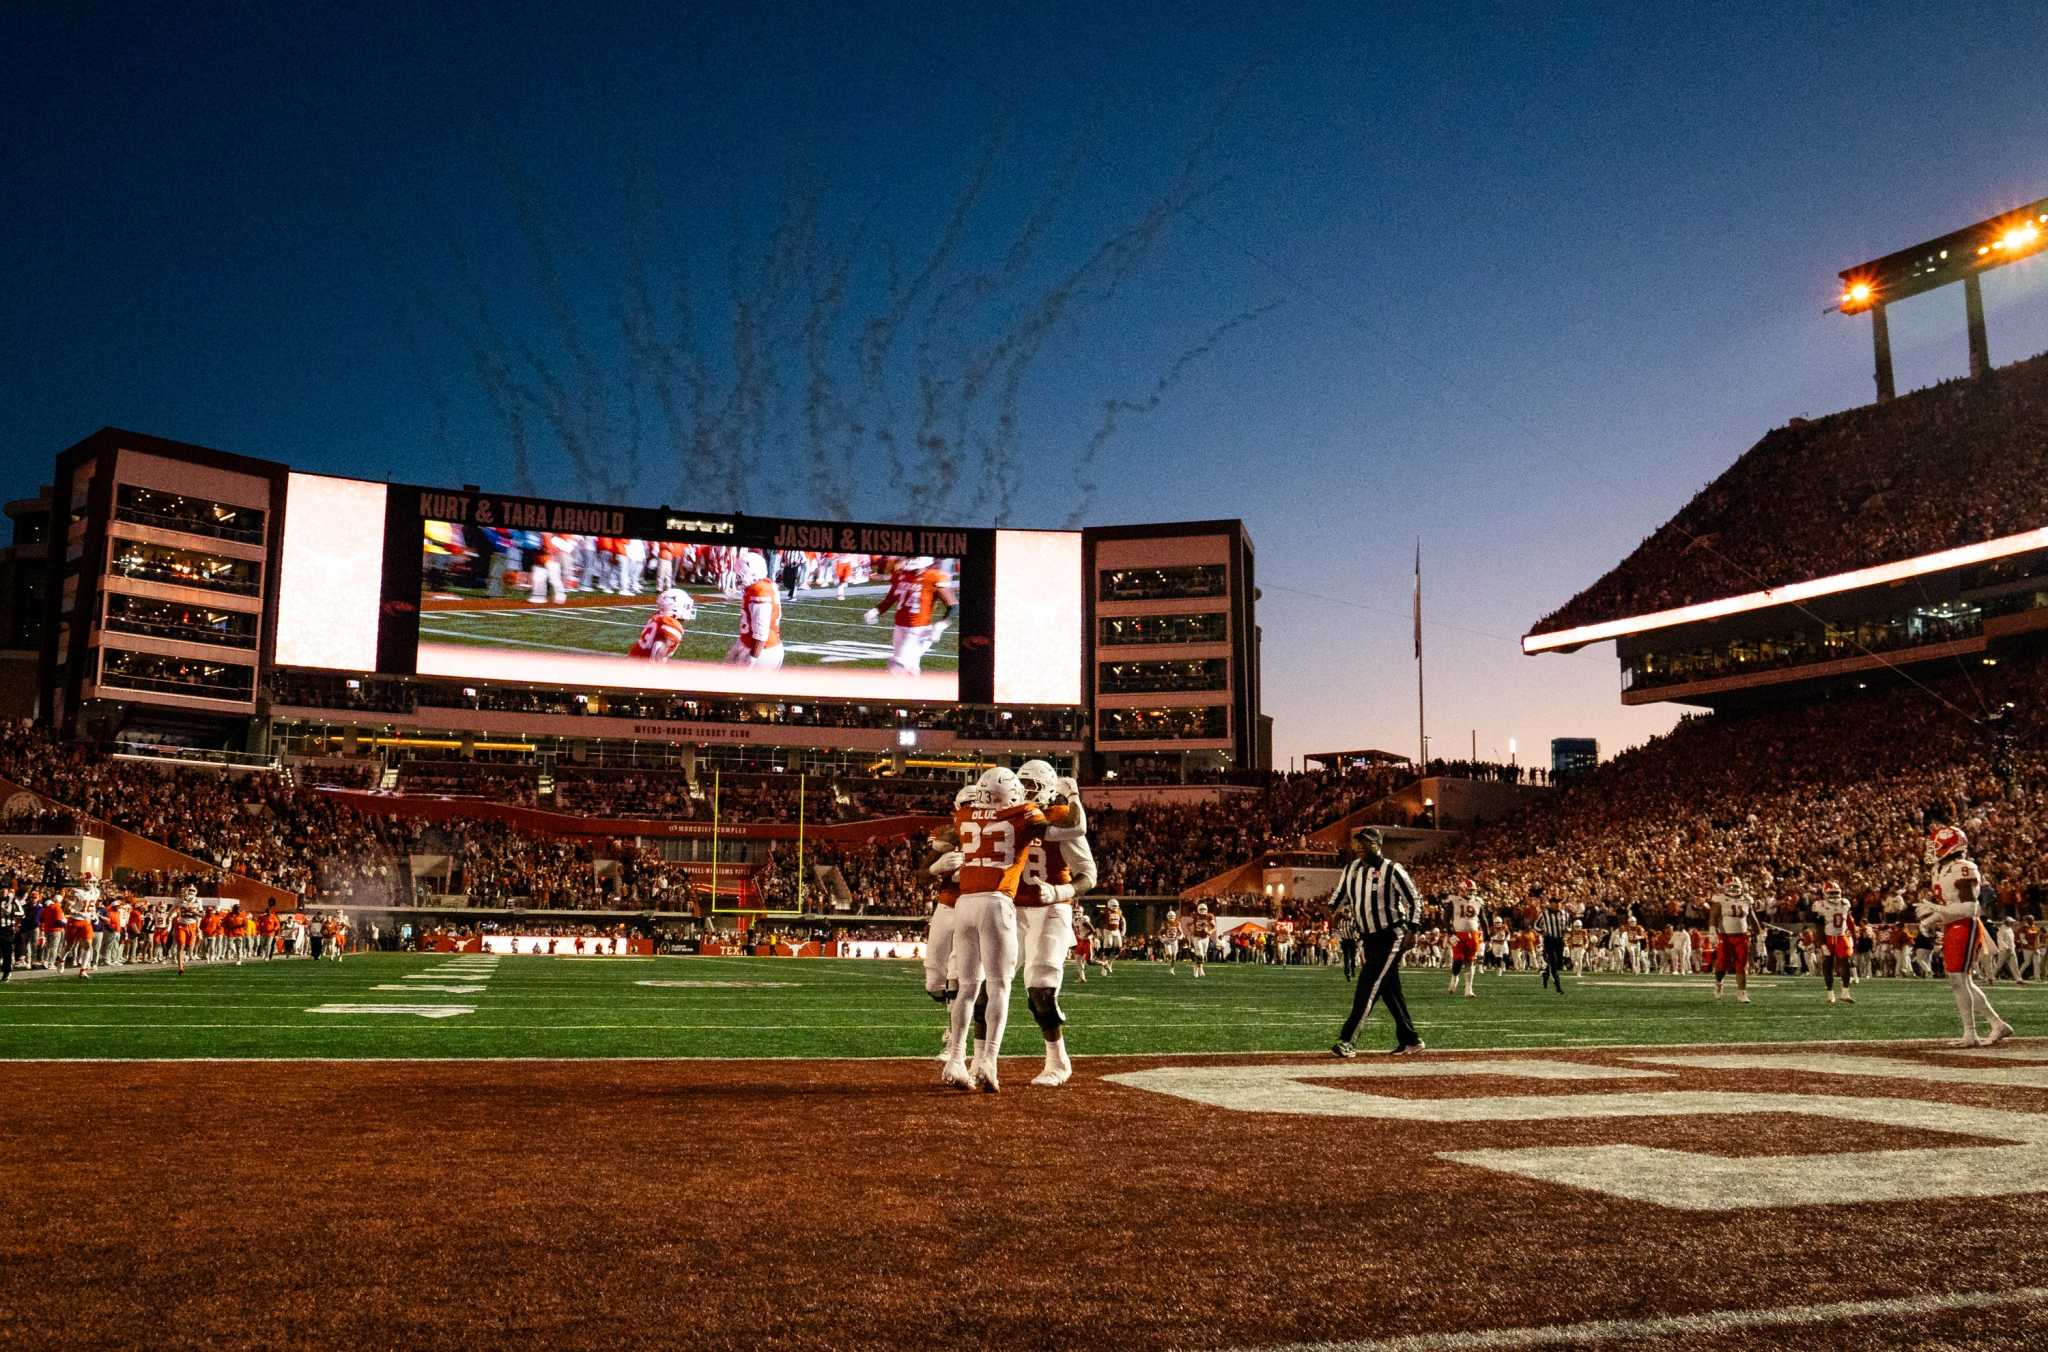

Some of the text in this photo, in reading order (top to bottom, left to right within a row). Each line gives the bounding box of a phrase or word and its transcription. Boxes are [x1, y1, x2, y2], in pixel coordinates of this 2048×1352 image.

[420, 492, 624, 535] KURT & TARA ARNOLD
[774, 525, 968, 555] JASON & KISHA ITKIN
[971, 811, 997, 820] BLUE
[960, 820, 1015, 870] 23
